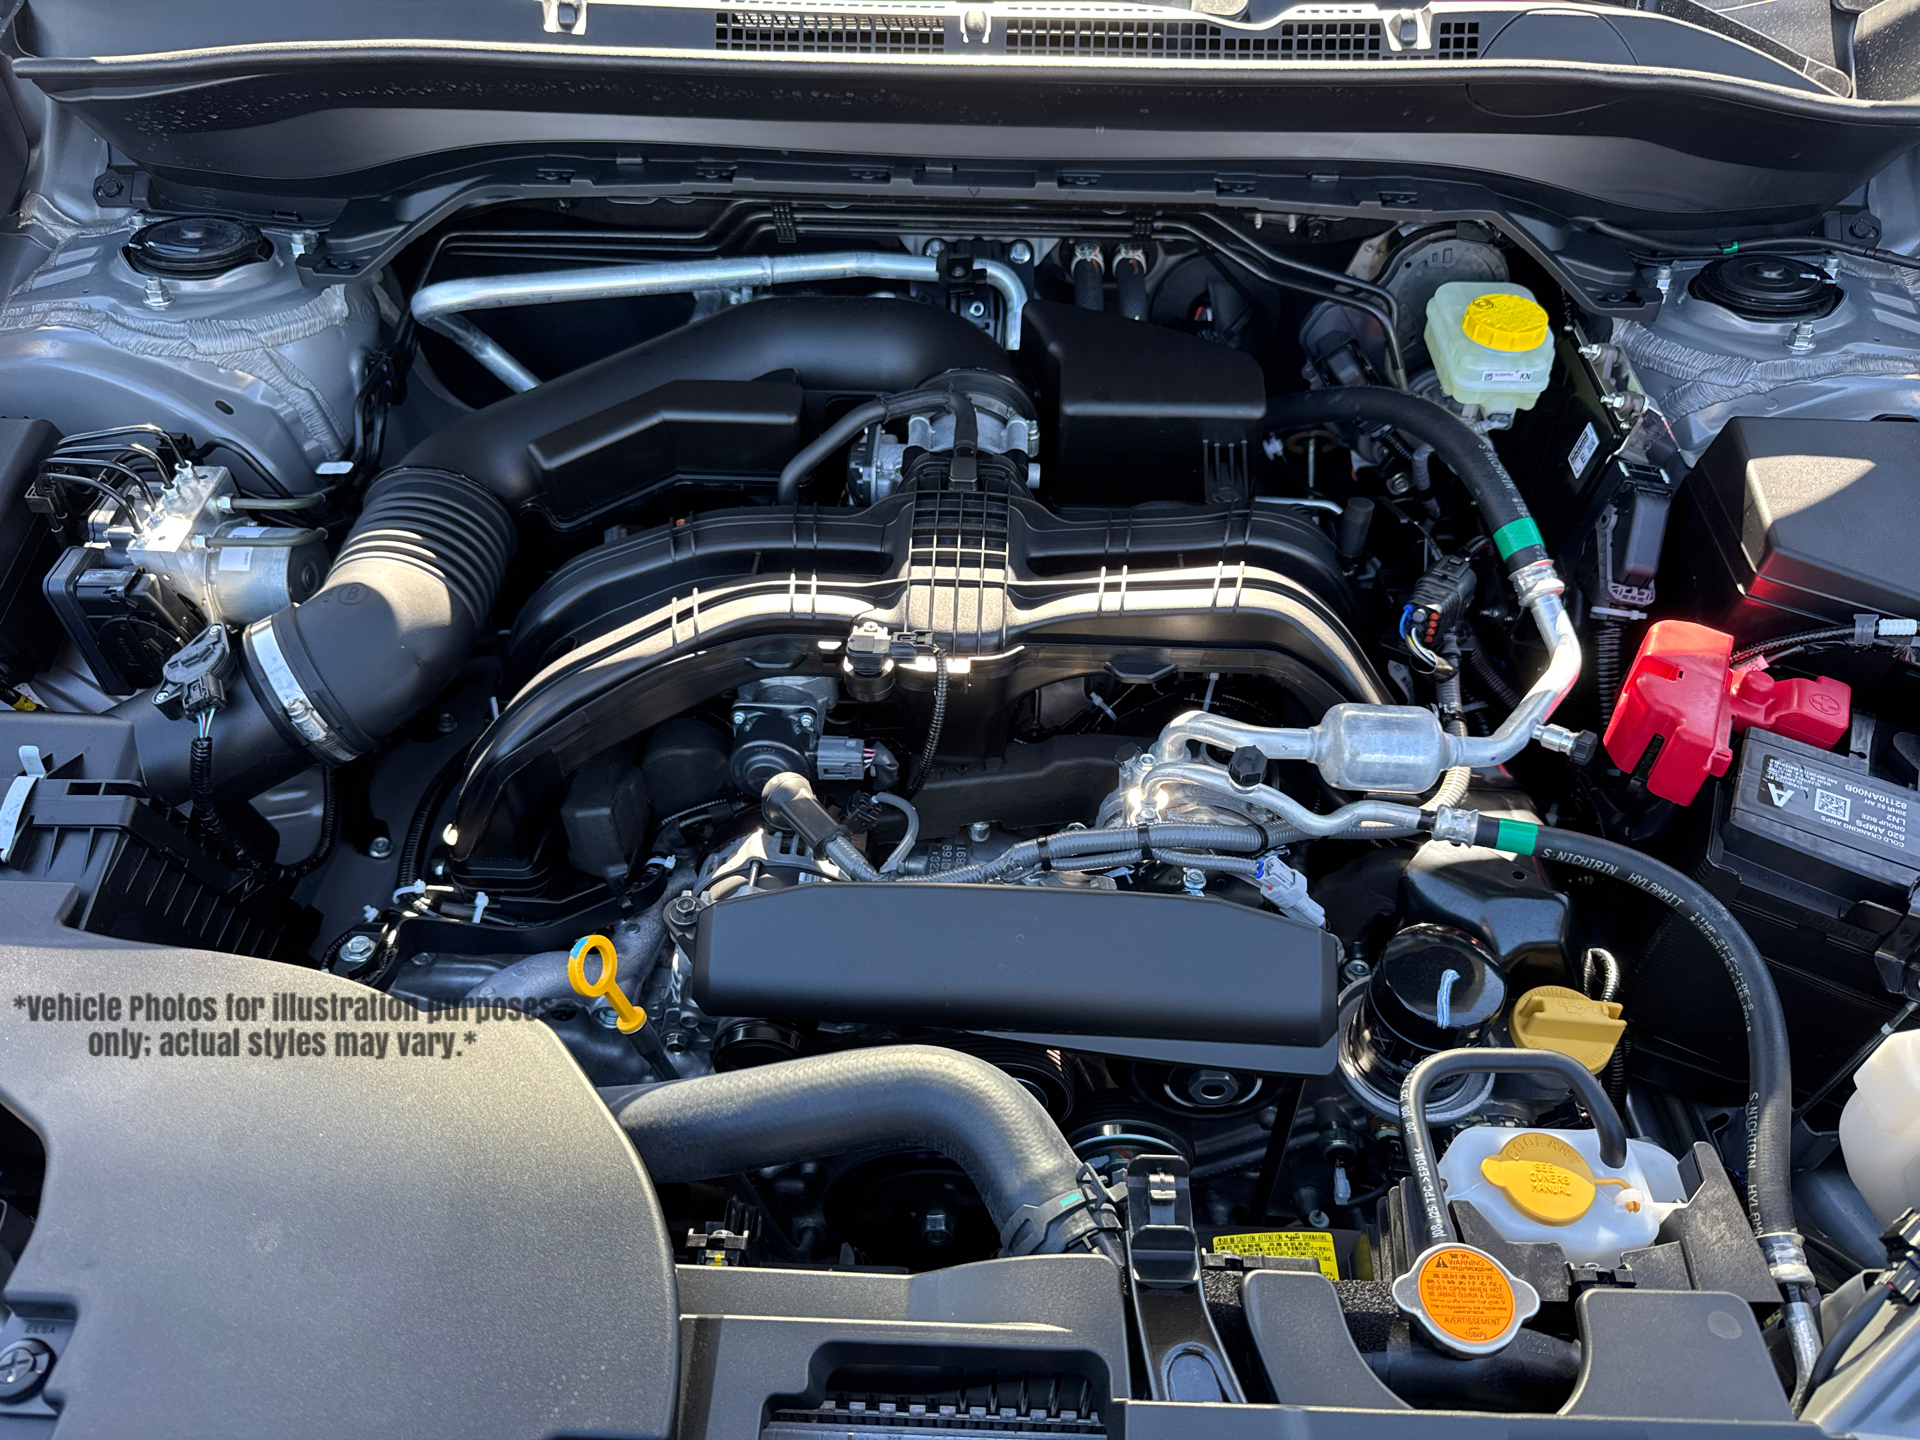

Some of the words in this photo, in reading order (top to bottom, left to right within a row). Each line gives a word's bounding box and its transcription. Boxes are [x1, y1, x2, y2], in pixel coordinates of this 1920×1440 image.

[1767, 782, 1796, 808] A
[1844, 784, 1908, 810] 82110AN00B
[1820, 815, 1842, 826] AMPS
[1861, 813, 1878, 823] SIZE
[1886, 813, 1906, 826] LN2
[1843, 822, 1882, 840] CRANKING
[1855, 819, 1885, 834] AMPS
[1879, 820, 1906, 833] GROUP
[1883, 836, 1905, 848] COLD
[1887, 830, 1905, 841] 620
[1627, 872, 1685, 908] HYLAMMIT
[1507, 1135, 1582, 1164] COOLANT
[1533, 1162, 1555, 1174] SEE
[1531, 1182, 1572, 1197] MANUAL
[1444, 1317, 1501, 1326] AVERTISSEMENT
